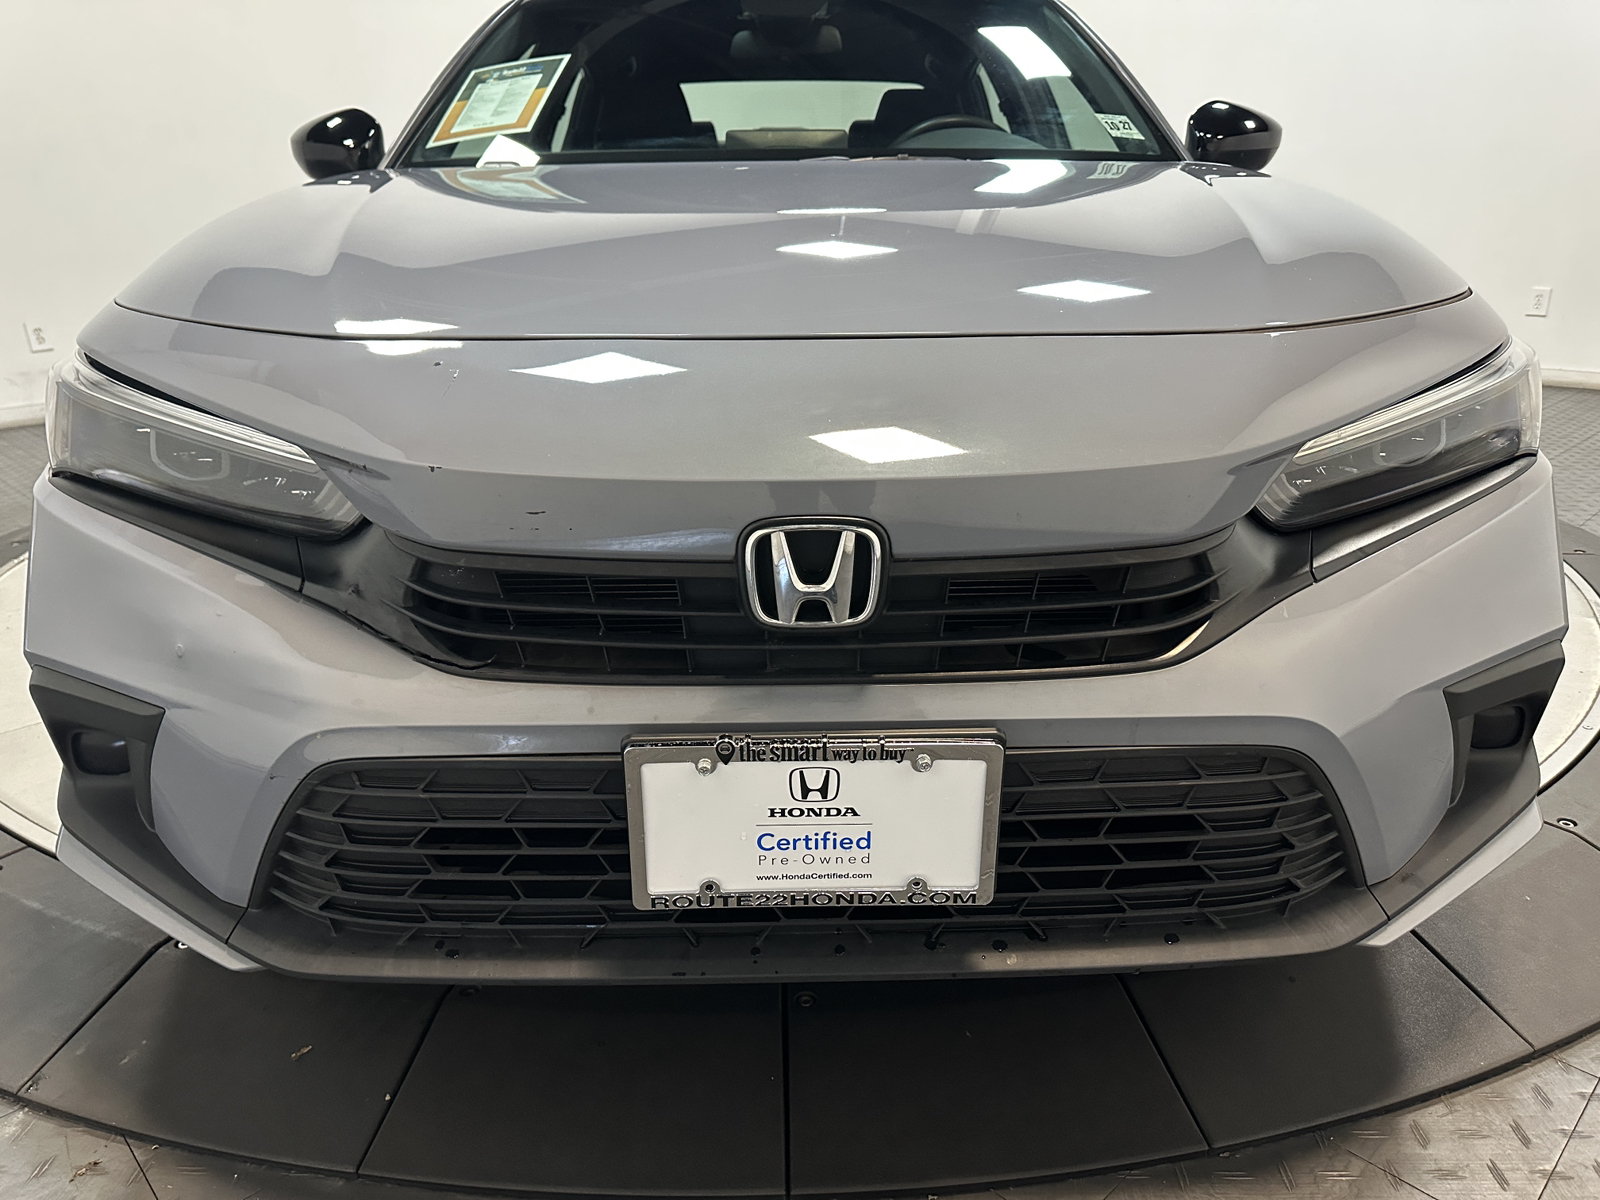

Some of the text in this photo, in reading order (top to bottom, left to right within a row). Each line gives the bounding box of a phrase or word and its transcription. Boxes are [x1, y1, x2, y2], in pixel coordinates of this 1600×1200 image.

[1105, 120, 1120, 131] 10
[739, 738, 907, 763] the smart way to buy
[768, 807, 861, 818] HONDA
[756, 830, 872, 851] Certified
[758, 852, 871, 866] Pre-Owned
[756, 872, 873, 881] www.HondaCertified.com
[650, 891, 978, 909] ROUTE22HONDA.COM
